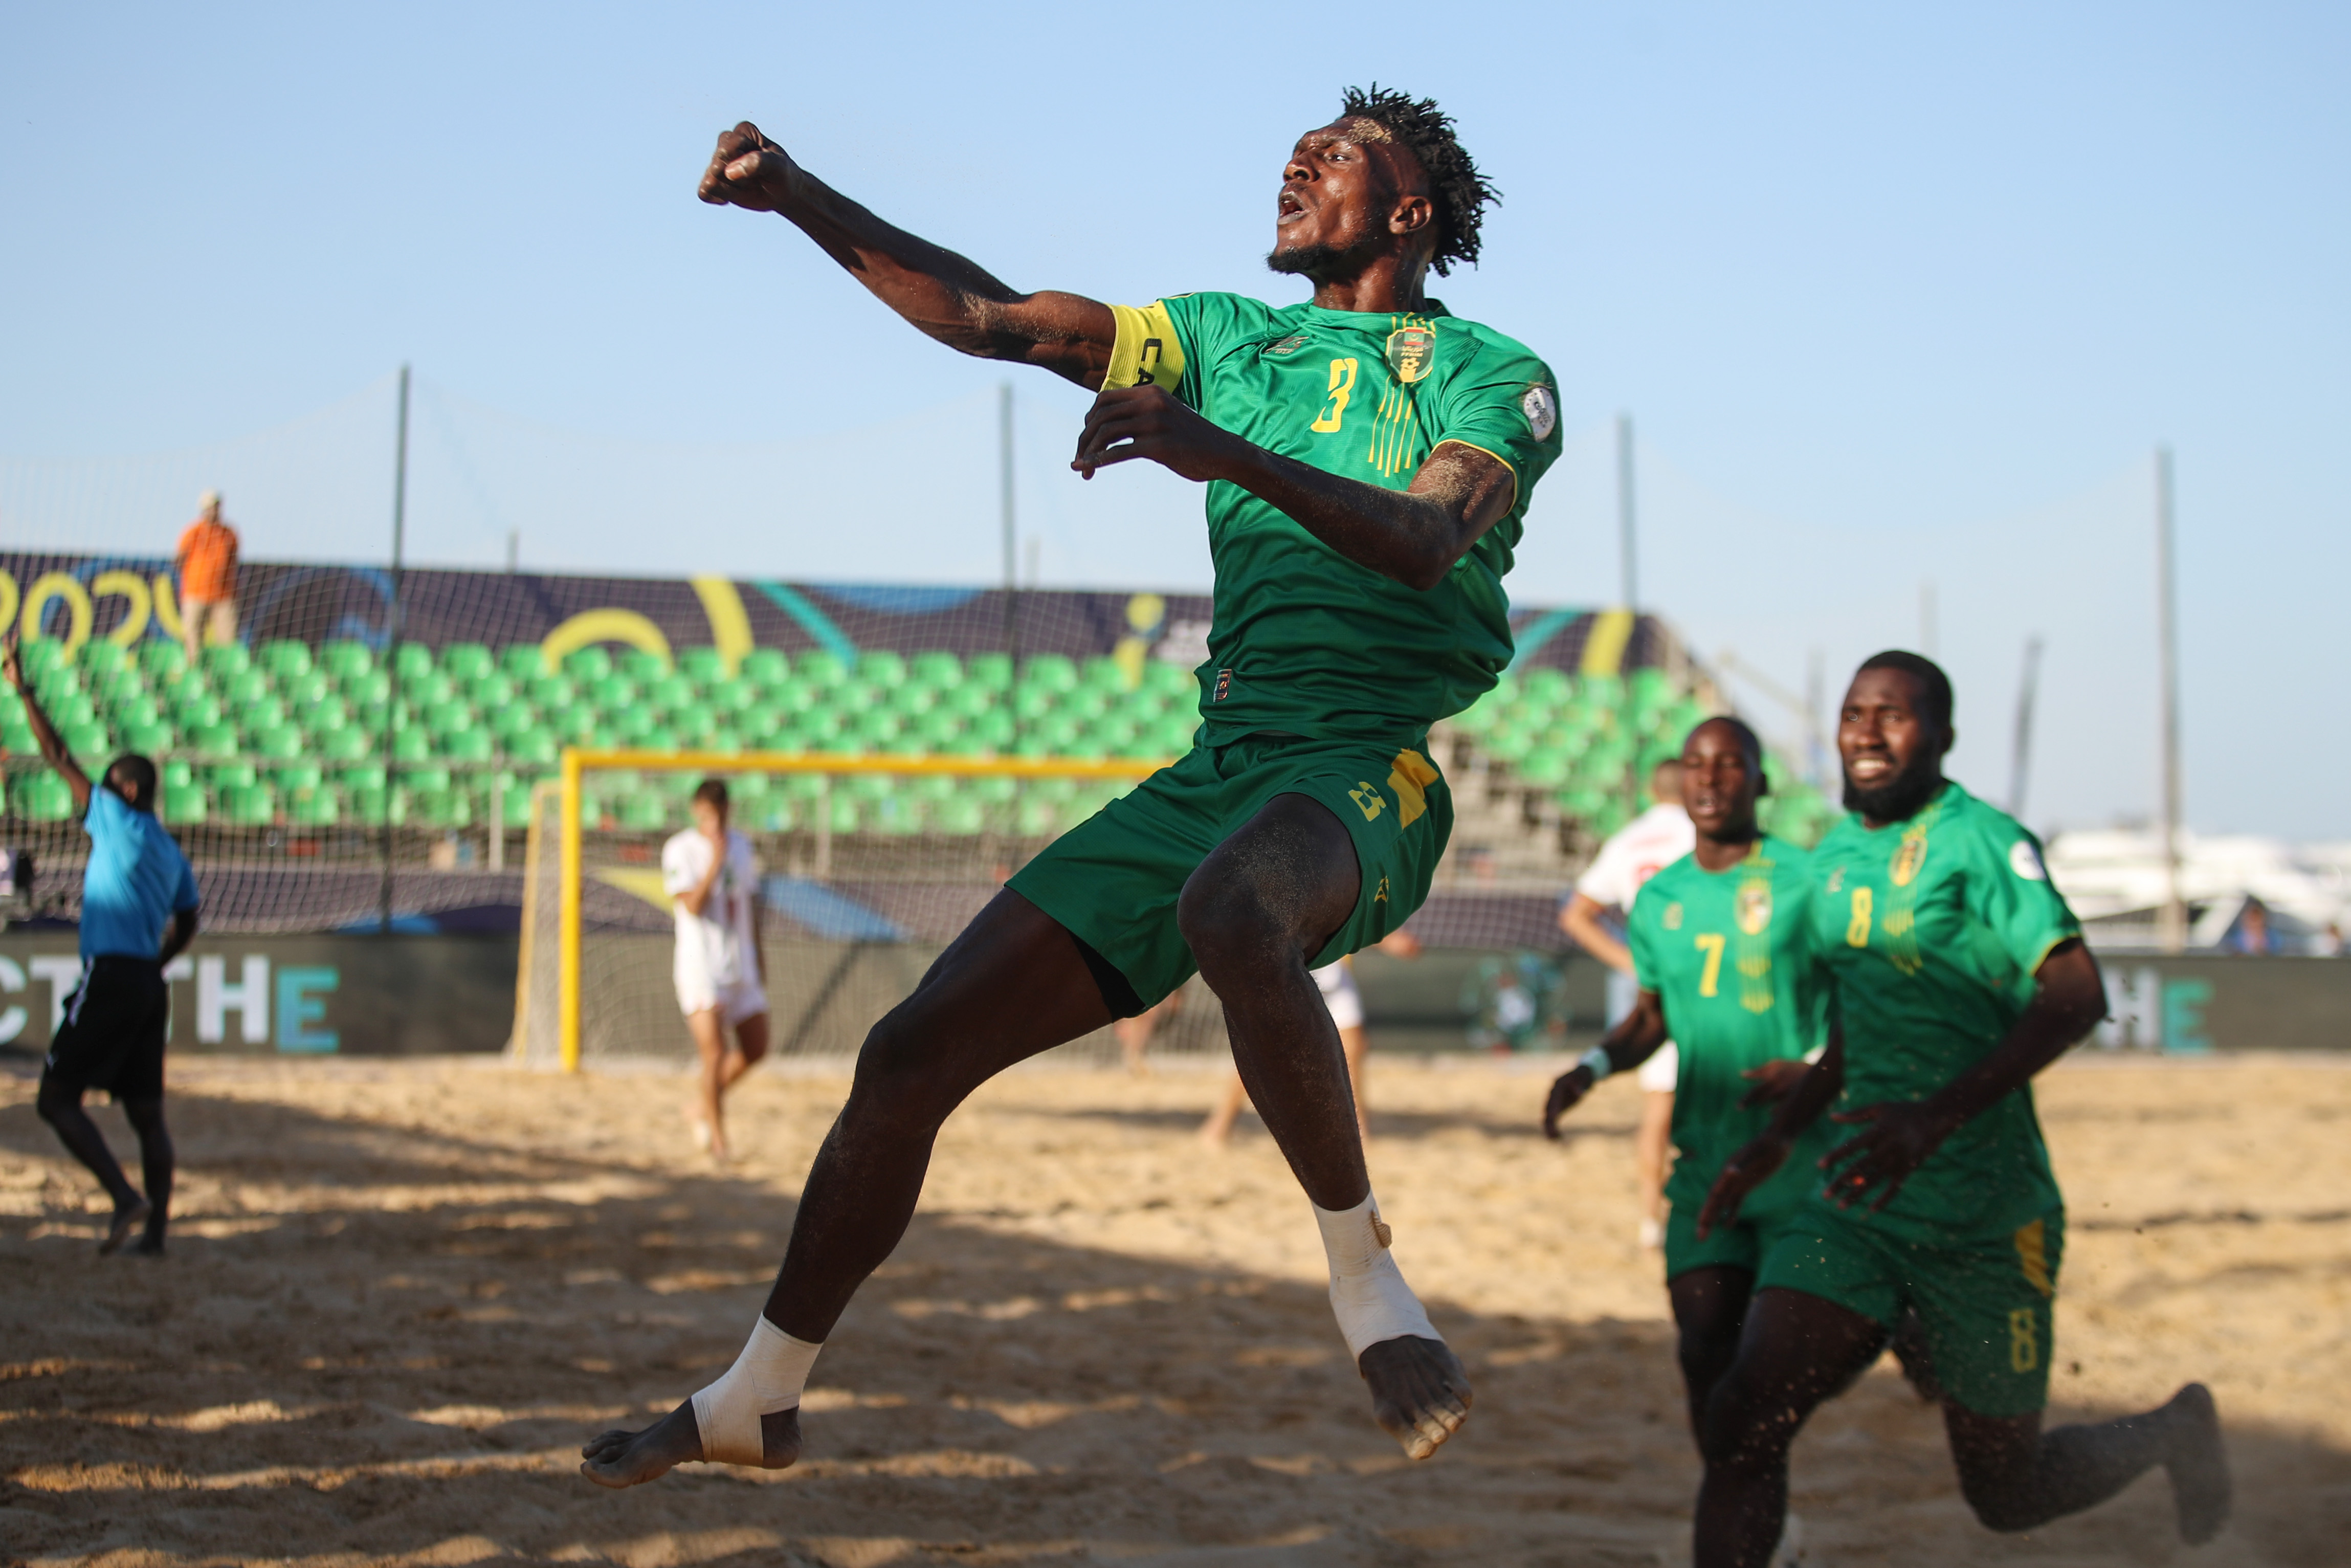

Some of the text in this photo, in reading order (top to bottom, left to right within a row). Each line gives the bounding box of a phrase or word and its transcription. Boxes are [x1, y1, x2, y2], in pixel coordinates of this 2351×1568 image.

[1310, 358, 1358, 431] 3
[1847, 886, 1872, 948] 8
[1694, 933, 1726, 998] 7
[2009, 1309, 2037, 1373] 8
